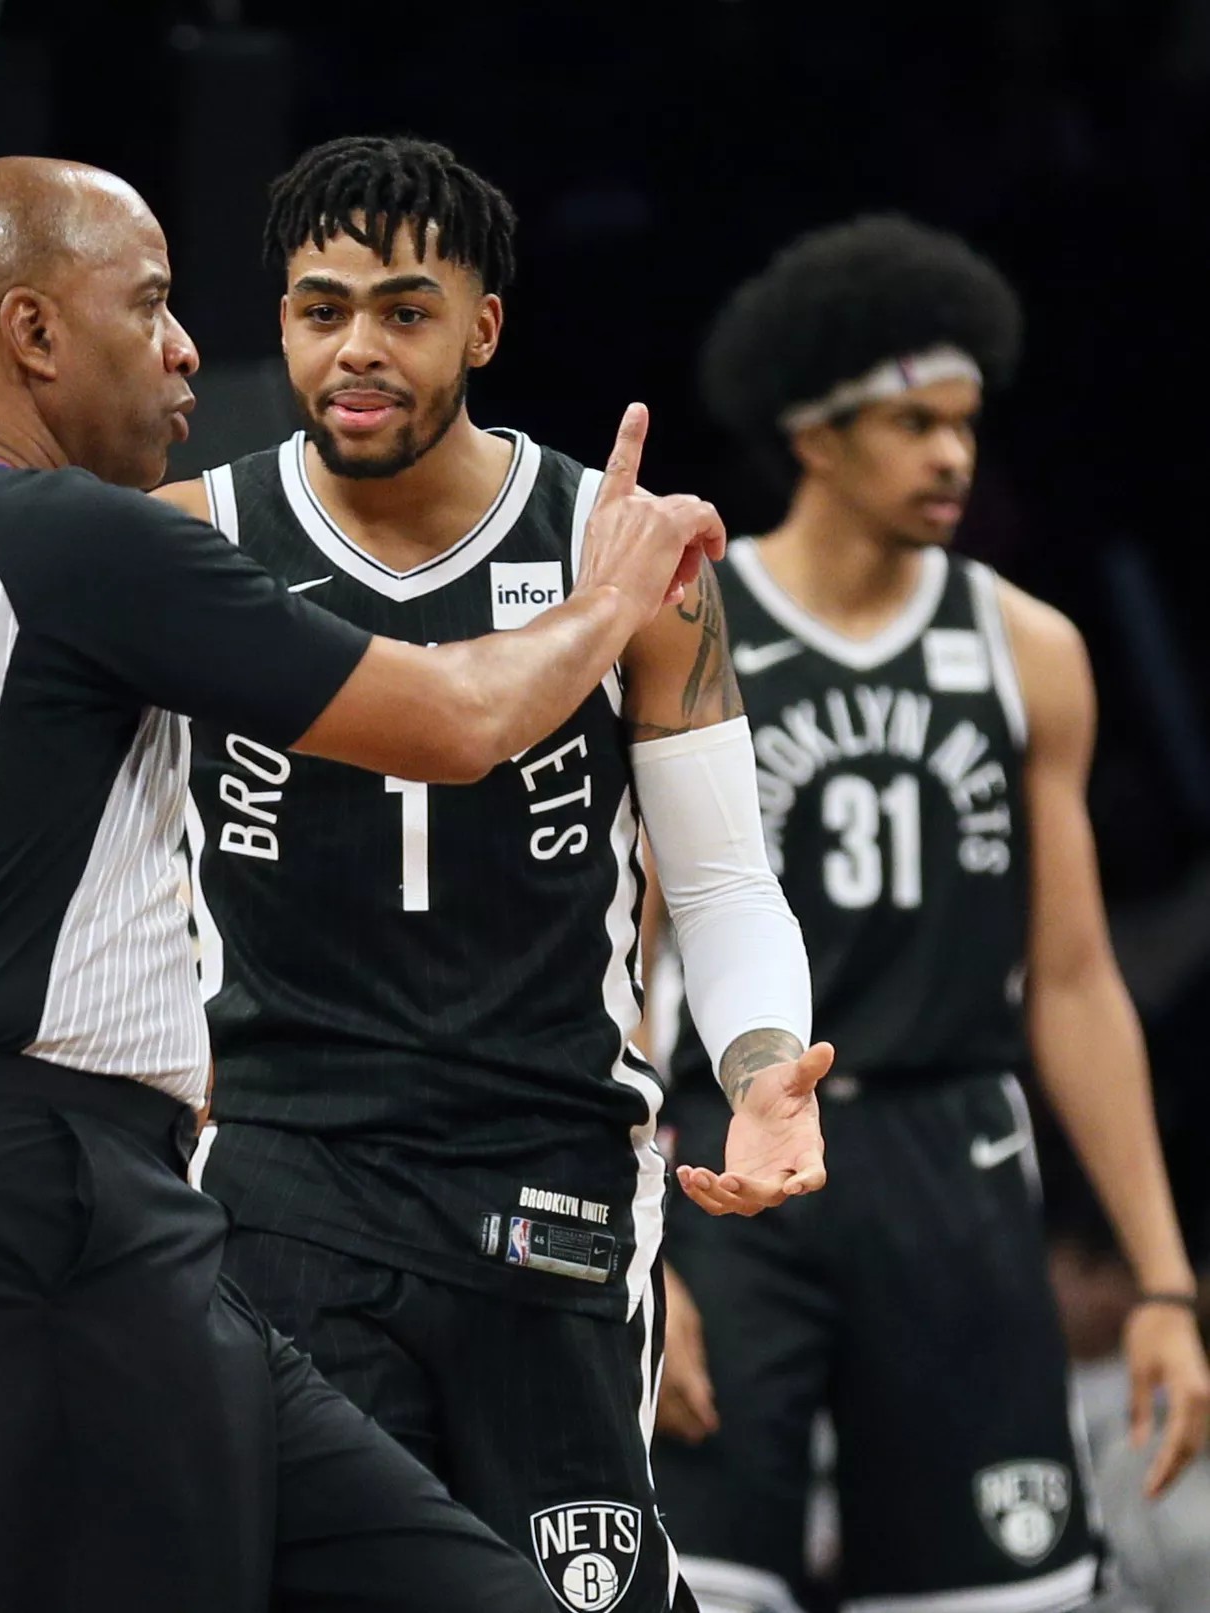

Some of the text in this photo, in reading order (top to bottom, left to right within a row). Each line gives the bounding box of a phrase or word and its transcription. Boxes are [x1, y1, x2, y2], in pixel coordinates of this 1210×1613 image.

[497, 582, 558, 605] infor
[510, 734, 591, 861] ETS
[821, 771, 923, 910] 31
[928, 719, 1012, 876] NETS
[384, 775, 429, 911] 1
[519, 1186, 580, 1217] BROOKLYN
[539, 1507, 637, 1561] NETS
[583, 1562, 600, 1603] B
